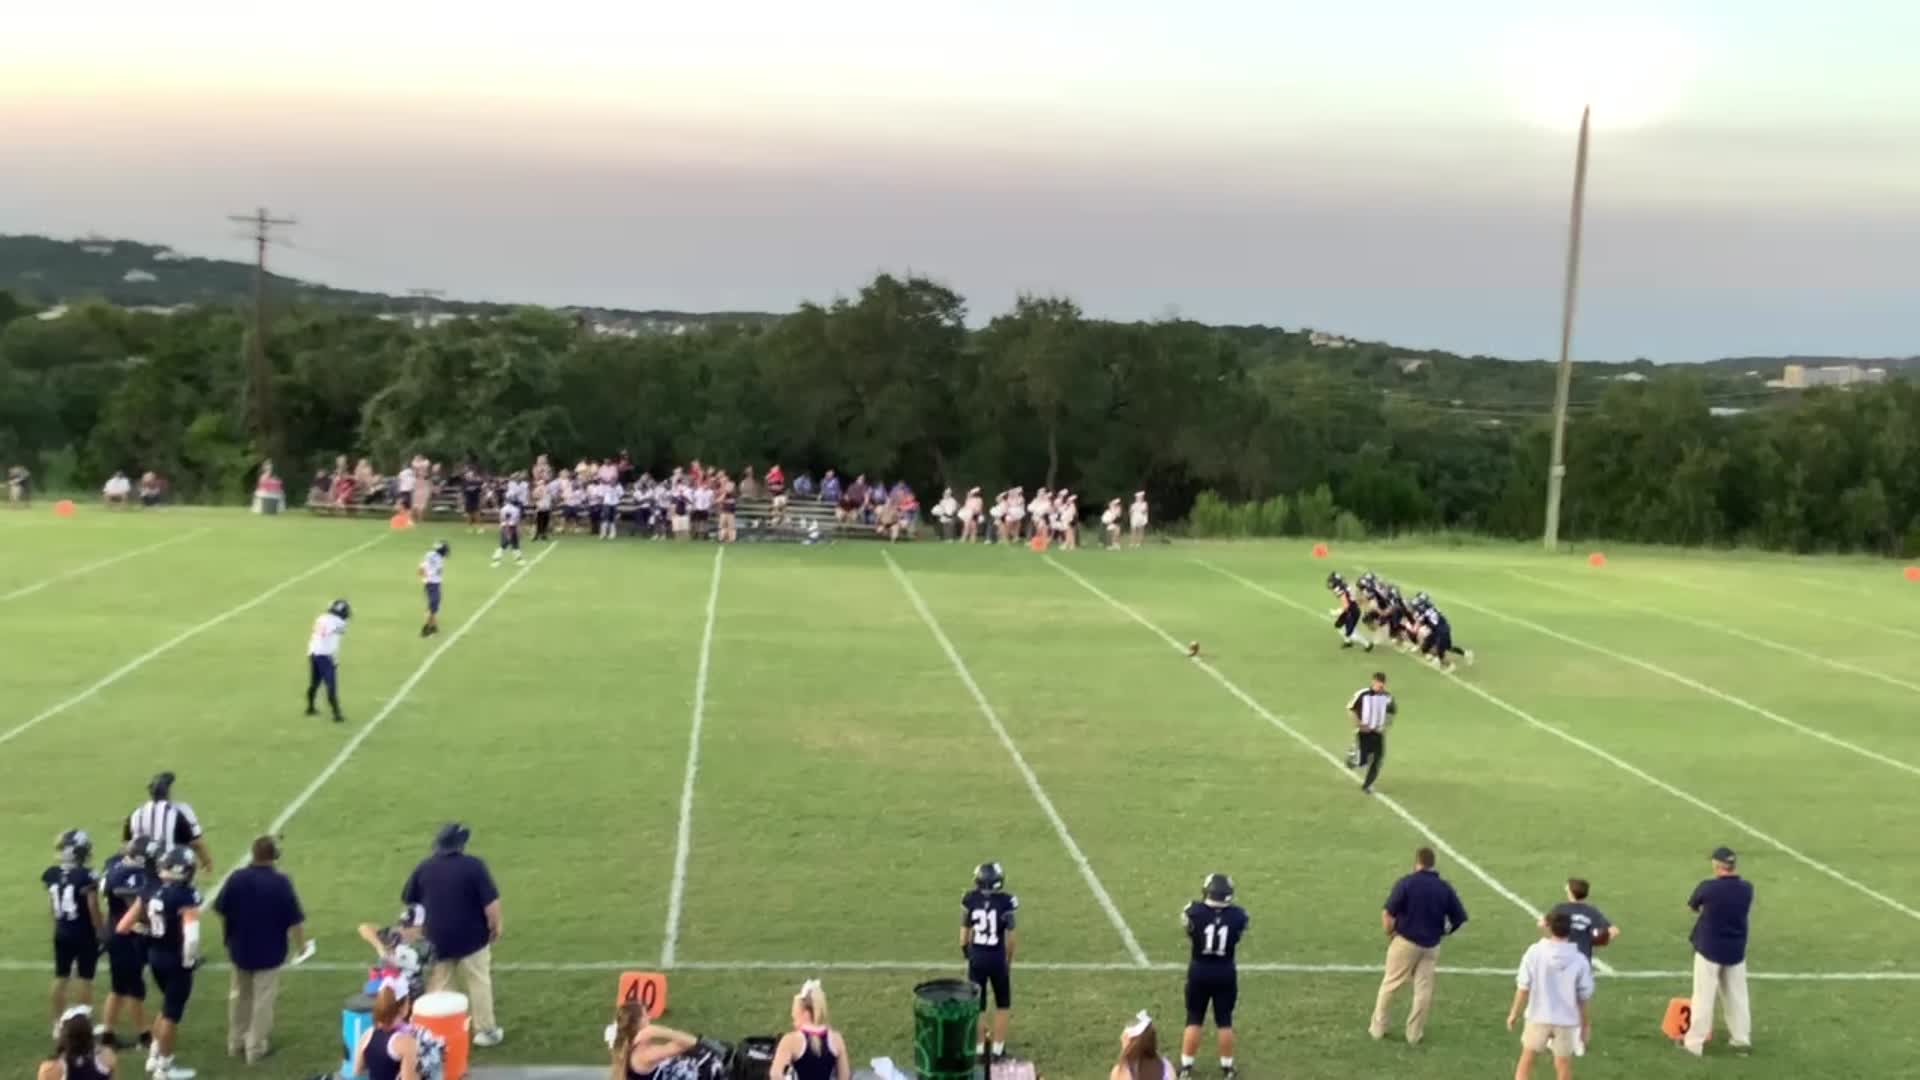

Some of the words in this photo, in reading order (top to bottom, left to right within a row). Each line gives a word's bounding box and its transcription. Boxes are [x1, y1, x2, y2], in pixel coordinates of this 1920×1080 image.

[48, 883, 79, 921] 14
[971, 908, 999, 946] 21
[1202, 924, 1228, 956] 11
[624, 979, 657, 1013] 40
[1680, 1005, 1692, 1035] 3
